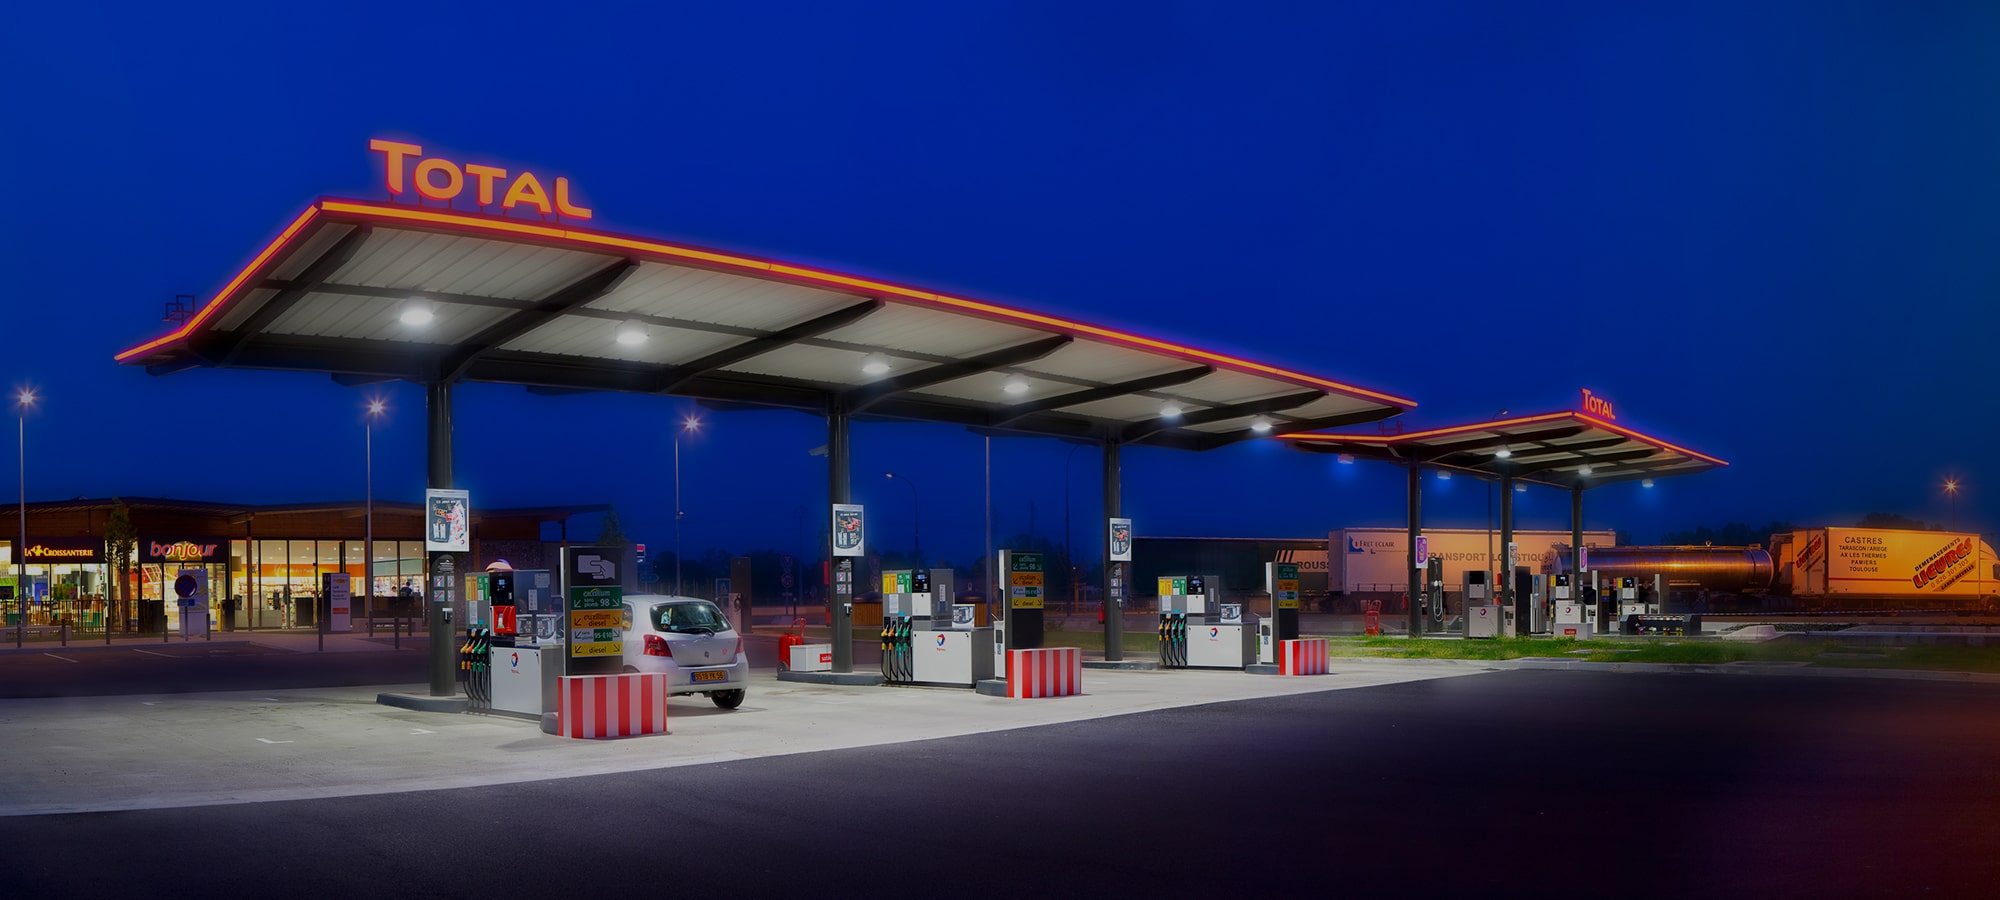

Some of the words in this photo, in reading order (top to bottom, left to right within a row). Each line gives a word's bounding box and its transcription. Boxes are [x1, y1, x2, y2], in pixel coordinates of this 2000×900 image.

[368, 138, 593, 220] TOTAL
[1582, 388, 1616, 420] TOTAL
[1844, 536, 1883, 545] CASTRES
[43, 547, 94, 557] CROISSANTERIE
[150, 540, 218, 560] bonjour
[1914, 537, 1961, 572] DEMENAGEMENTS
[1428, 552, 1487, 561] RANSPORT
[1297, 561, 1329, 570] ROUS
[600, 598, 610, 607] 98
